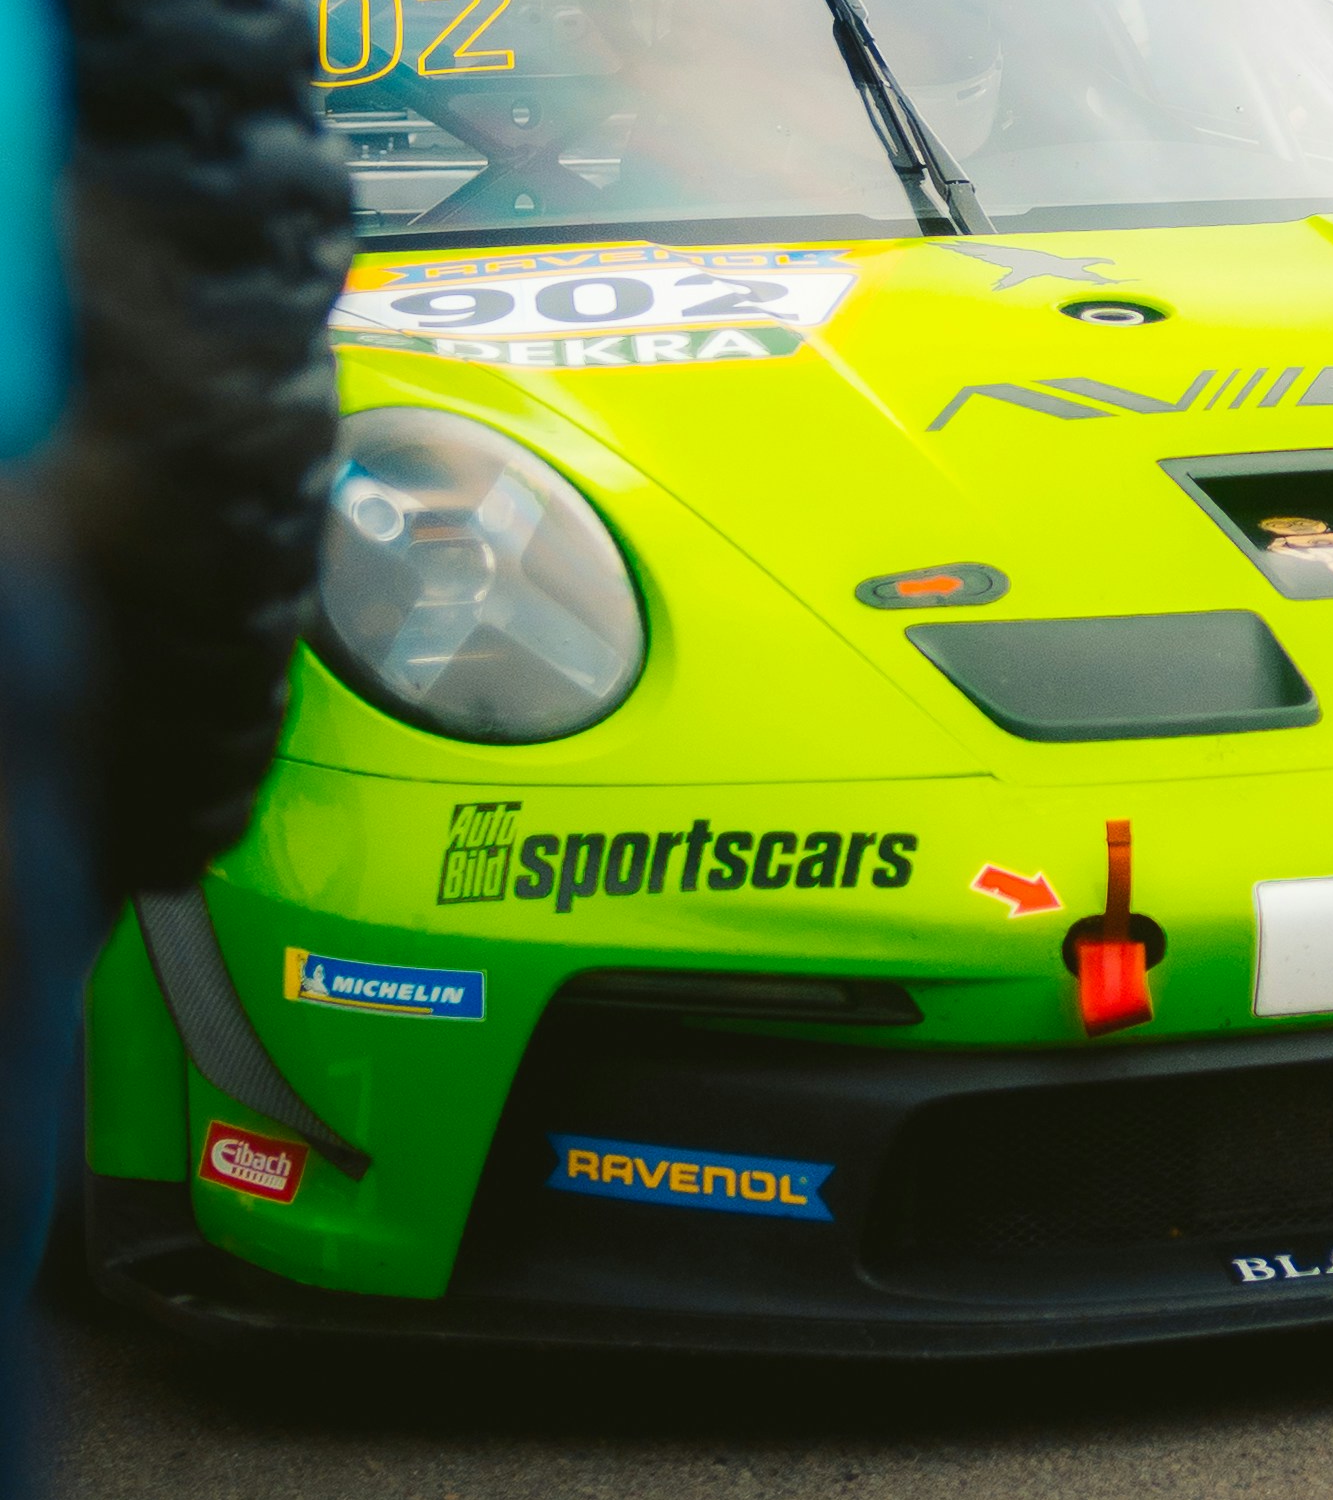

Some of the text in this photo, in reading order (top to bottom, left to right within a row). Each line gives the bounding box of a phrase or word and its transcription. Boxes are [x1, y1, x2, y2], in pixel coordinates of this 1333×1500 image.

[423, 249, 819, 280] RAVENOL
[390, 273, 800, 328] 902
[436, 329, 770, 367] DEKRA
[449, 802, 519, 850] Auto
[441, 847, 507, 900] Bild
[513, 819, 919, 914] sportscars
[331, 975, 466, 1005] MICHELIN
[210, 1138, 292, 1178] Eibach
[566, 1148, 809, 1206] RAVENOL
